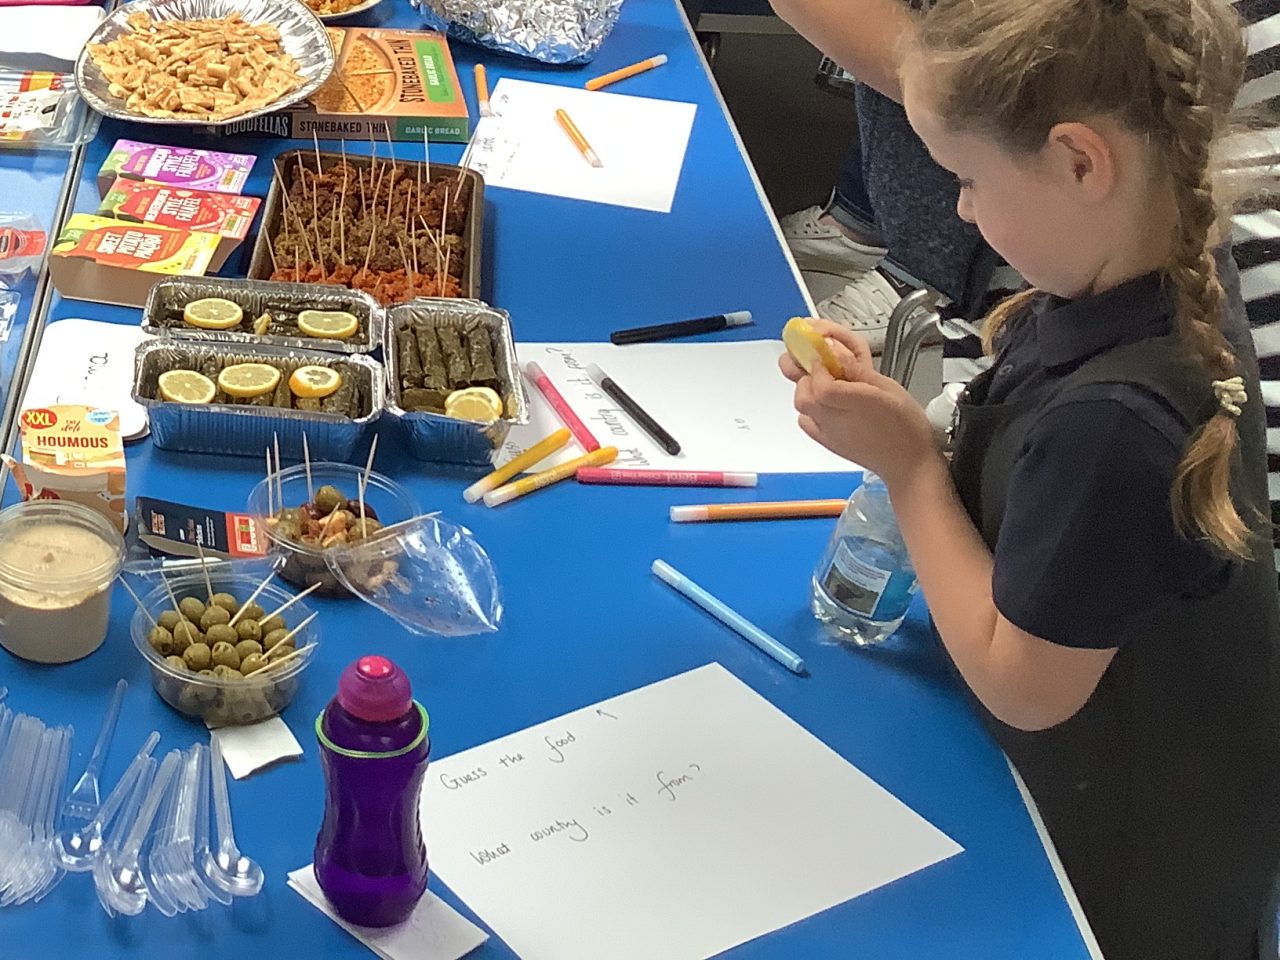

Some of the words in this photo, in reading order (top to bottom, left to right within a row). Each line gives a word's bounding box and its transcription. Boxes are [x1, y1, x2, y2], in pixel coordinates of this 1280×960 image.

[385, 39, 414, 54] THIN
[397, 56, 425, 103] STONEBAKED
[300, 120, 362, 134] STONEBAKED
[405, 126, 433, 135] GARLC
[434, 126, 461, 136] BREAD
[26, 411, 53, 426] XXL
[37, 436, 109, 448] HOUMOUS
[440, 767, 487, 792] Guess
[498, 750, 525, 769] the
[544, 731, 577, 763] food
[469, 842, 511, 866] What
[530, 816, 588, 842] country
[593, 805, 612, 818] is
[619, 792, 639, 807] it
